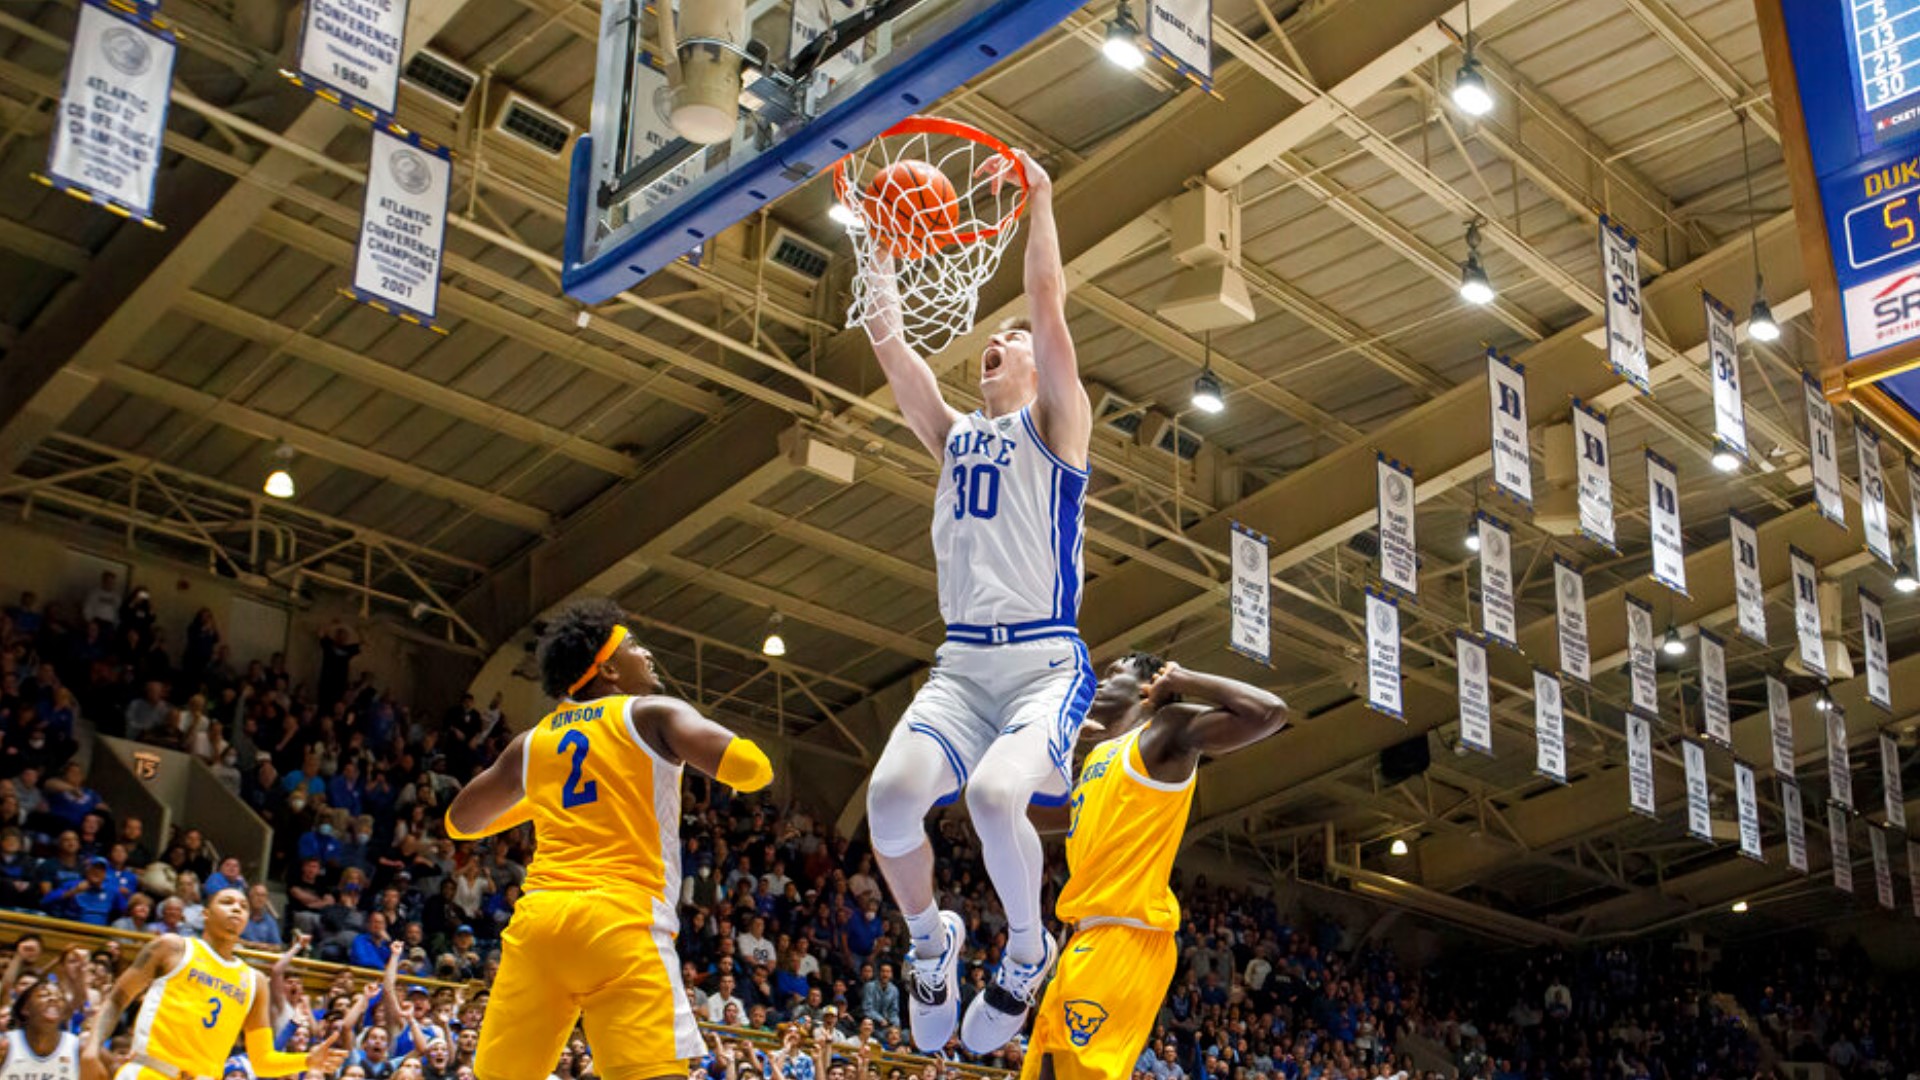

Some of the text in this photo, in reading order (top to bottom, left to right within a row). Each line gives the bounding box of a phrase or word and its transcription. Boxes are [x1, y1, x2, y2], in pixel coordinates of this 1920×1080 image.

[313, 0, 398, 50] CONFERENCE
[314, 17, 394, 65] CHAMPIONS
[1870, 21, 1895, 51] 13
[1873, 46, 1902, 77] 25
[1875, 71, 1905, 101] 30
[1864, 156, 1920, 198] DUK
[379, 195, 432, 227] ATLANTIC
[386, 214, 424, 238] COAST
[366, 220, 438, 261] CONFERENCE
[367, 236, 433, 274] CHAMPIONS
[381, 277, 413, 298] 2001
[952, 462, 1001, 520] 30
[551, 706, 605, 731] HINSON
[557, 728, 598, 809] 2
[187, 967, 247, 1006] PANTHERS
[201, 996, 222, 1029] 3
